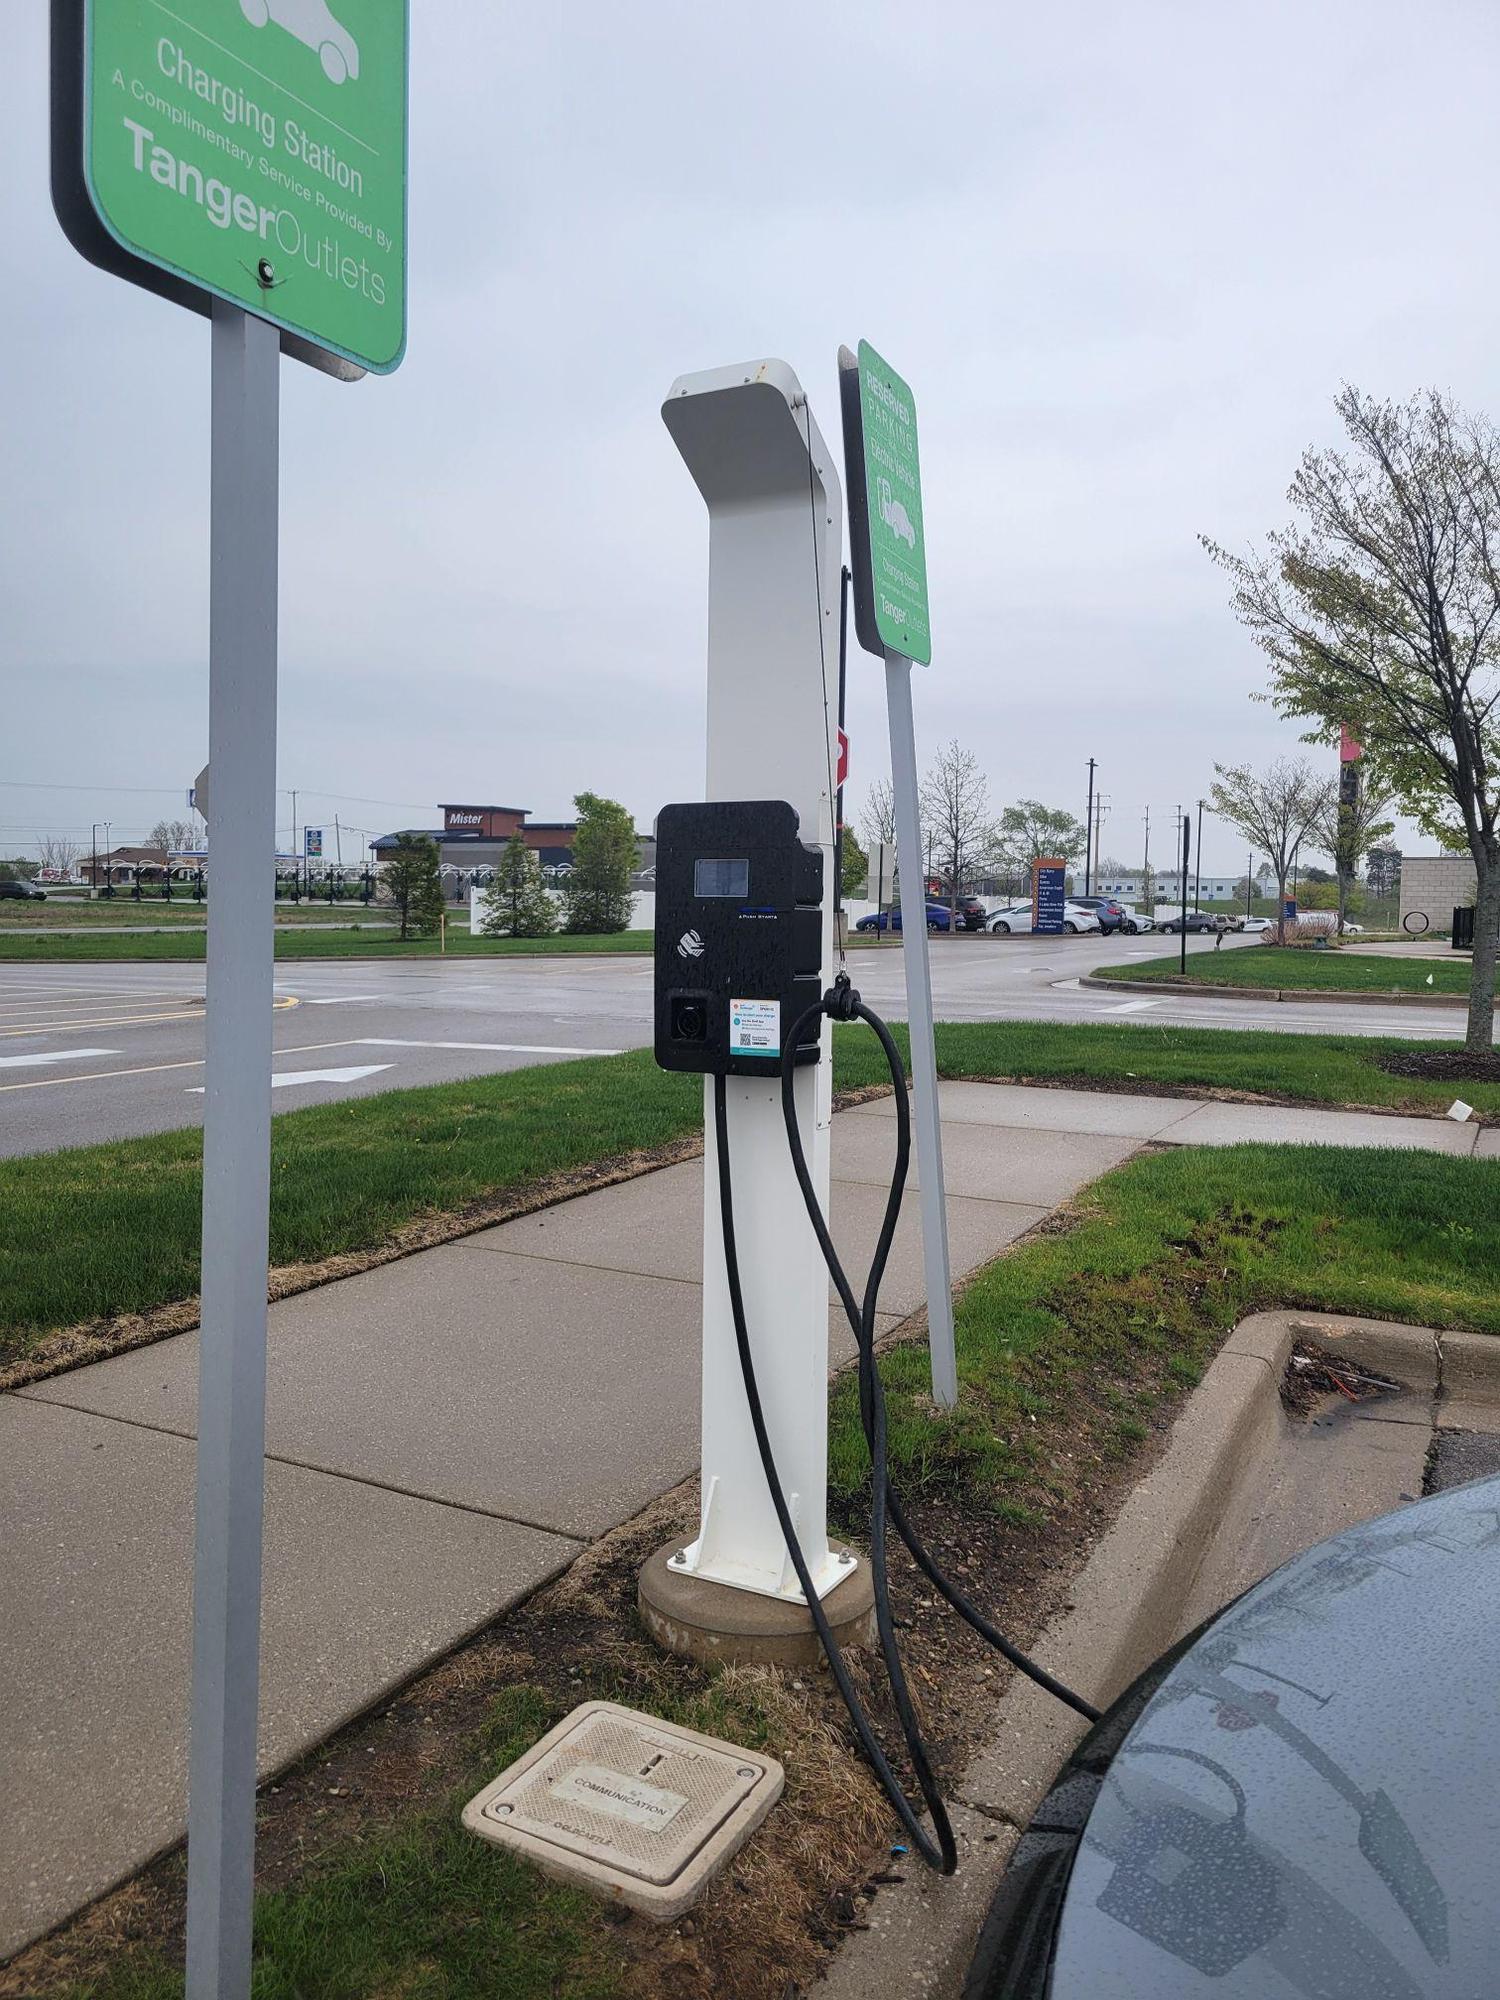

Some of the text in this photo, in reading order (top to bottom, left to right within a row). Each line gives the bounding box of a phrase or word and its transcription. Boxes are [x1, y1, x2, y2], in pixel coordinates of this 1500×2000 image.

[156, 37, 363, 198] Charging Station
[111, 68, 393, 253] A Complimentary Service Provided By
[866, 368, 910, 426] RESERVED
[868, 396, 913, 453] PARKING
[449, 812, 484, 824] Mister
[574, 1777, 669, 1816] COMMUNICATION
